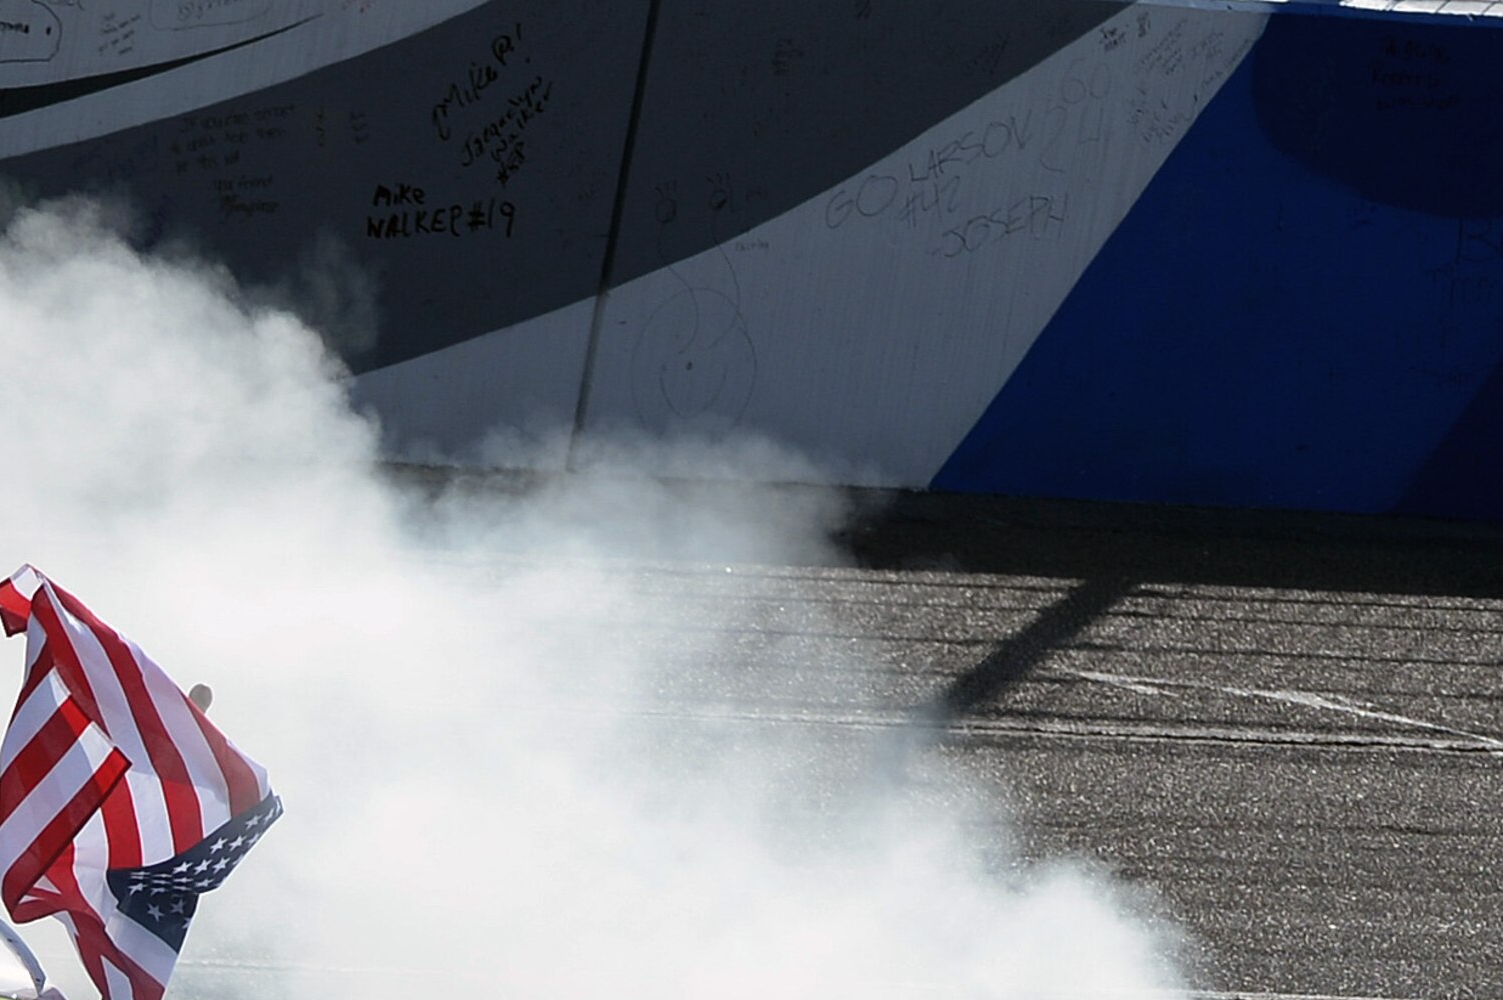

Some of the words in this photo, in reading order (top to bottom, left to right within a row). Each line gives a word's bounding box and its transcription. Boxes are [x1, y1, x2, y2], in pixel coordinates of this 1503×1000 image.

[825, 173, 899, 229] GO
[908, 107, 1033, 183] LARSON
[467, 198, 517, 239] #19
